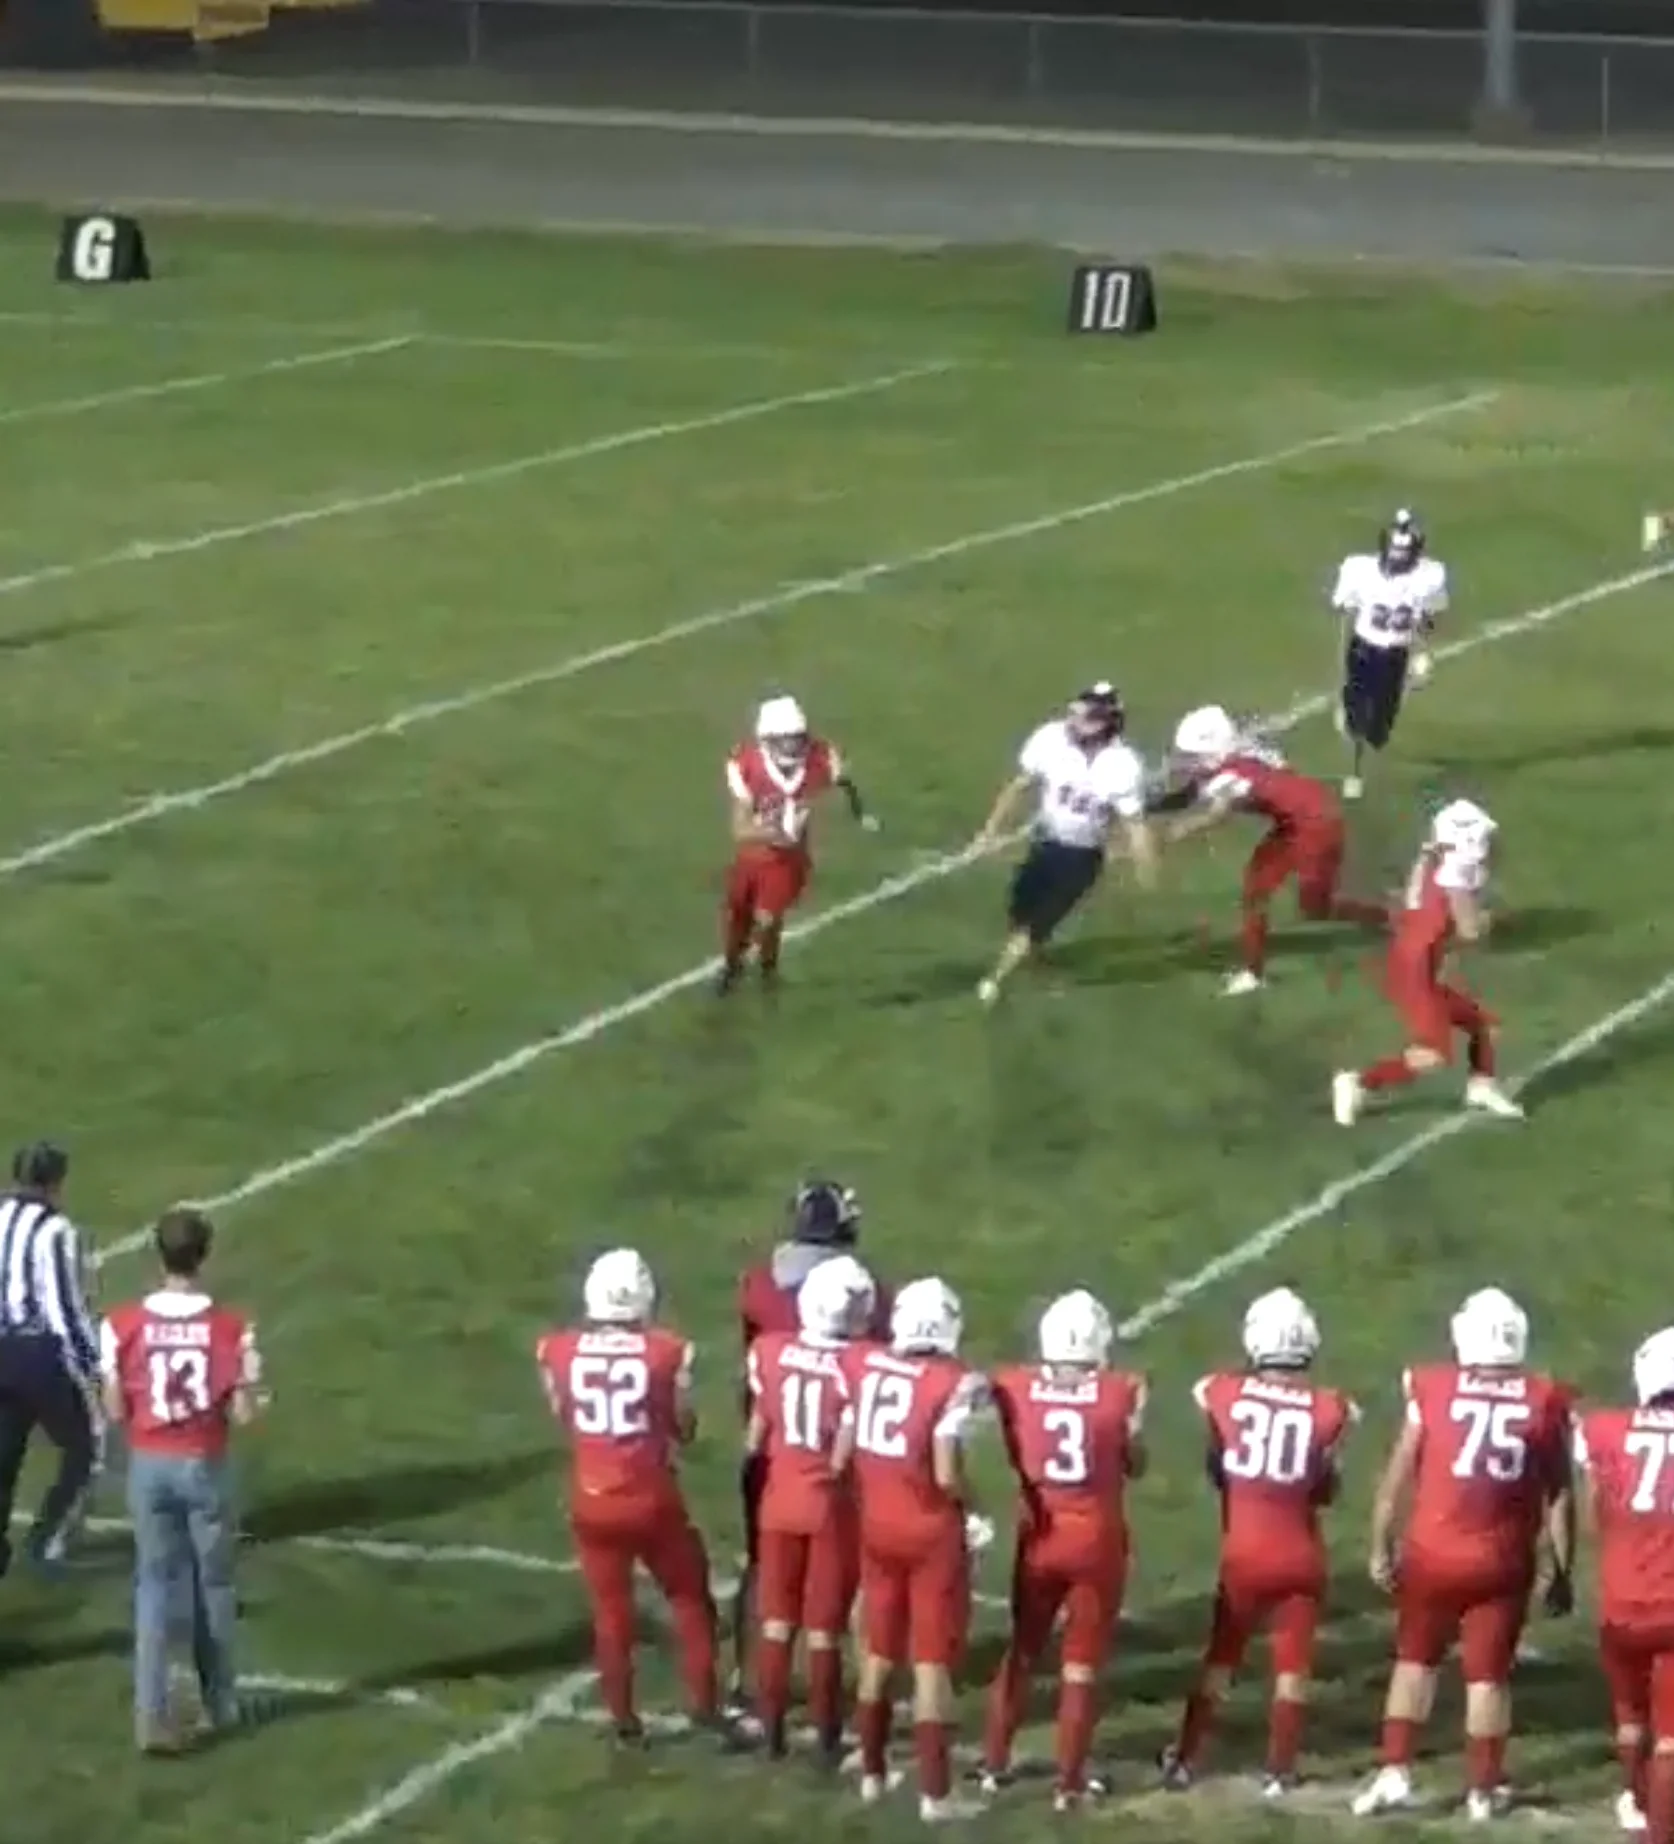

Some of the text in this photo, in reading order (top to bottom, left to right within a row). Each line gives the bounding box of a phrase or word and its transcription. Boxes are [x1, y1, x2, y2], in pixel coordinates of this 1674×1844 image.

[73, 217, 116, 280] G
[1080, 270, 1132, 329] 10
[147, 1351, 210, 1422] 13
[569, 1358, 648, 1434] 52
[781, 1374, 822, 1448] 11
[856, 1371, 914, 1457] 12
[1044, 1411, 1088, 1483] 3
[1223, 1400, 1312, 1482] 30
[1451, 1400, 1530, 1480] 75
